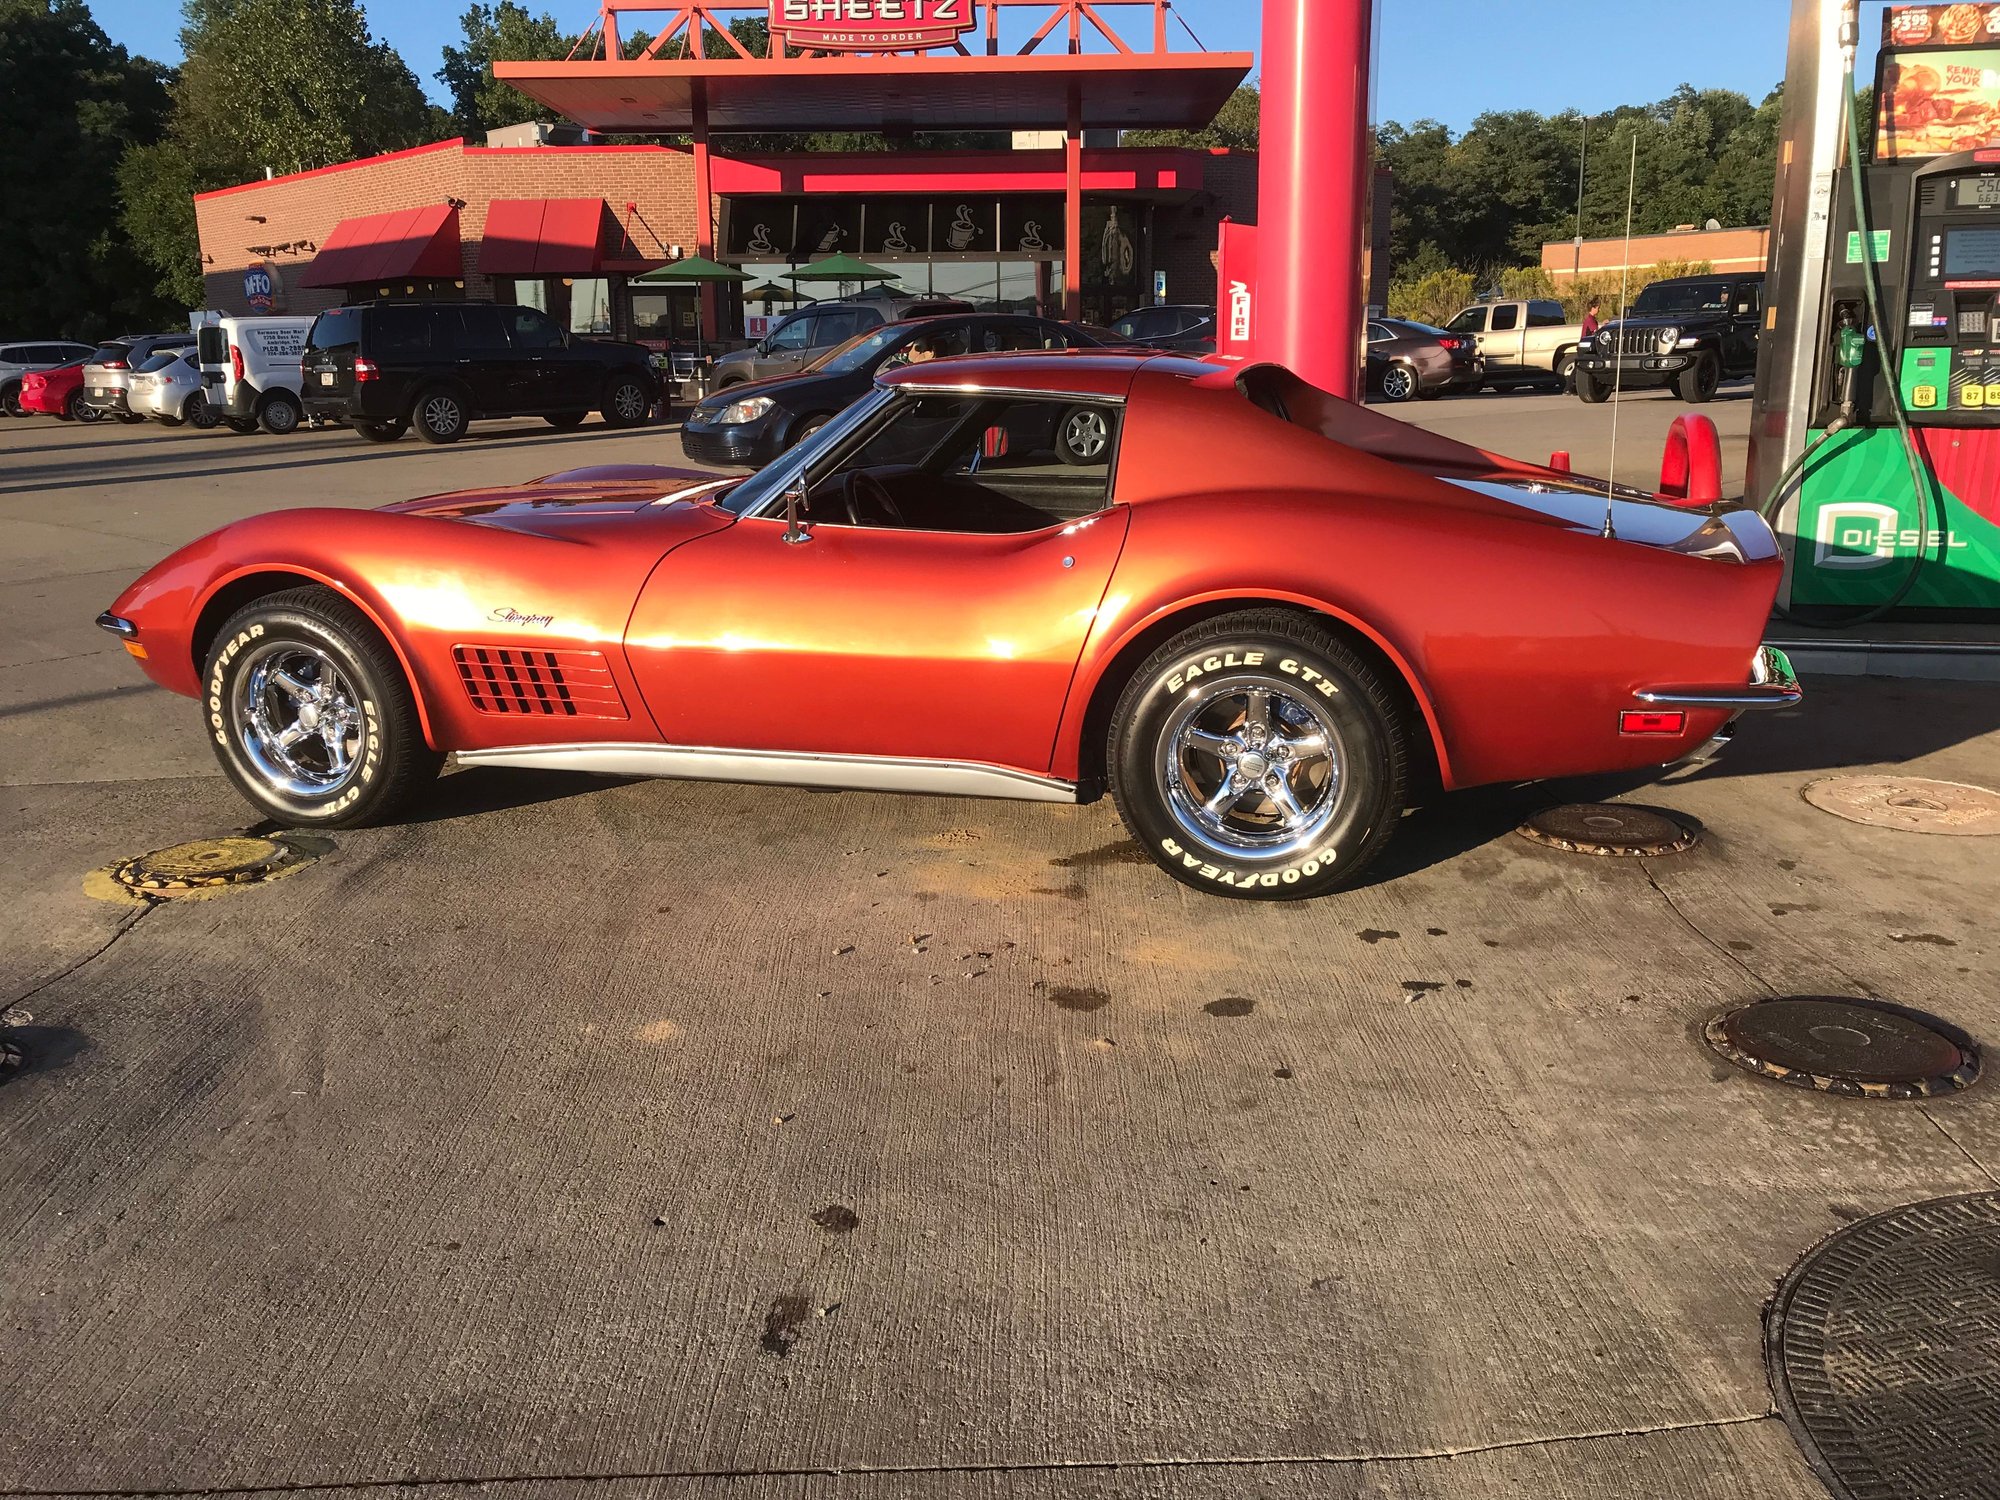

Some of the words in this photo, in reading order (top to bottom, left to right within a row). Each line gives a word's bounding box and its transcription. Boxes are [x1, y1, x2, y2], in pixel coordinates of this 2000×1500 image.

[784, 0, 959, 21] SHEETZ
[822, 33, 855, 42] MADE
[861, 33, 875, 42] TO
[882, 32, 923, 41] ORDER
[1946, 64, 1981, 77] REMIX
[1946, 74, 1981, 88] YOUR
[1235, 296, 1247, 337] FIRE
[1966, 392, 1979, 400] 87
[1842, 529, 1968, 548] DIESEL
[487, 607, 554, 628] Stingray
[1166, 652, 1265, 694] EAGLE
[209, 624, 265, 745] GOODYEAR
[361, 699, 380, 783] EAGLE
[1161, 837, 1337, 889] GOODYEAR
